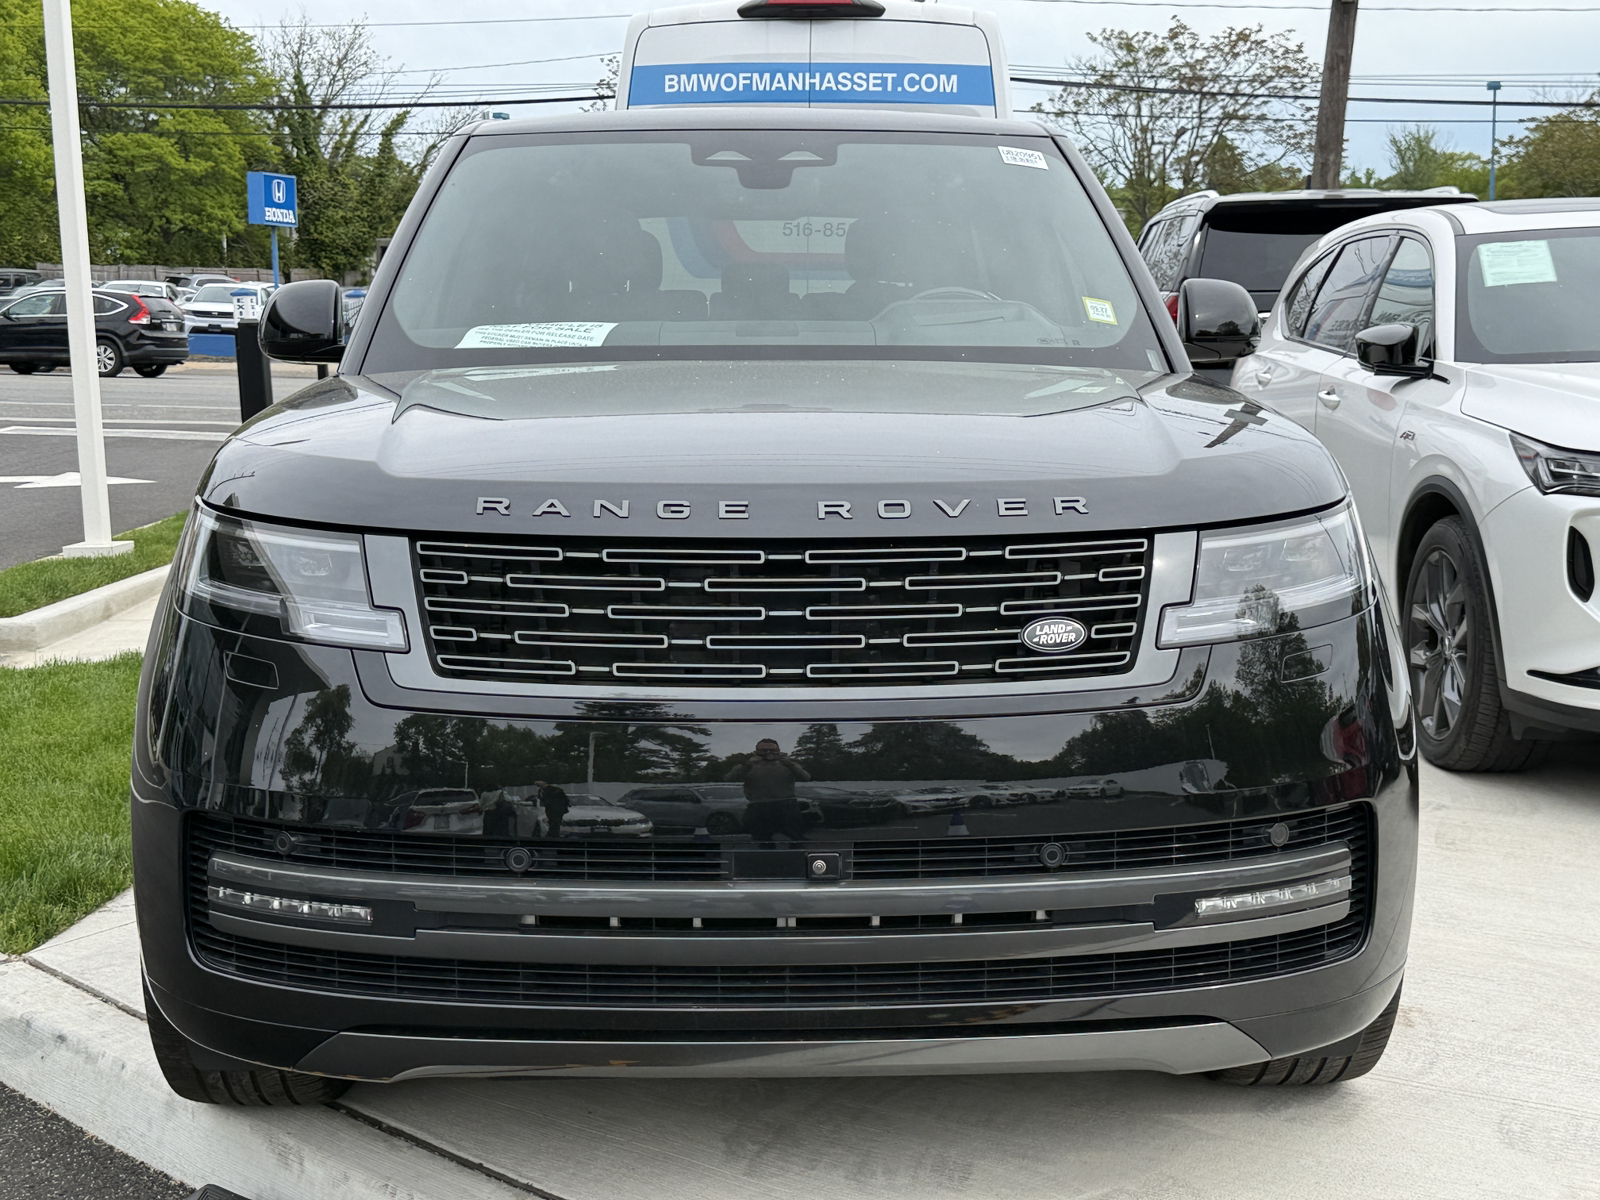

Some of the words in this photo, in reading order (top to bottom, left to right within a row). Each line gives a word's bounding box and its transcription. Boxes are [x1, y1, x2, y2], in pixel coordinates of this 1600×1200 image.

[664, 72, 958, 93] BMWOFMANHASSET.COM
[264, 207, 296, 223] HONDA
[782, 222, 846, 237] 516-85
[545, 330, 577, 340] RELEASE
[576, 333, 595, 342] DATE
[555, 325, 595, 334] SALE
[476, 496, 749, 520] RANGE
[816, 496, 1089, 520] ROVER
[1035, 623, 1066, 635] LAND
[1039, 632, 1076, 645] ROVER
